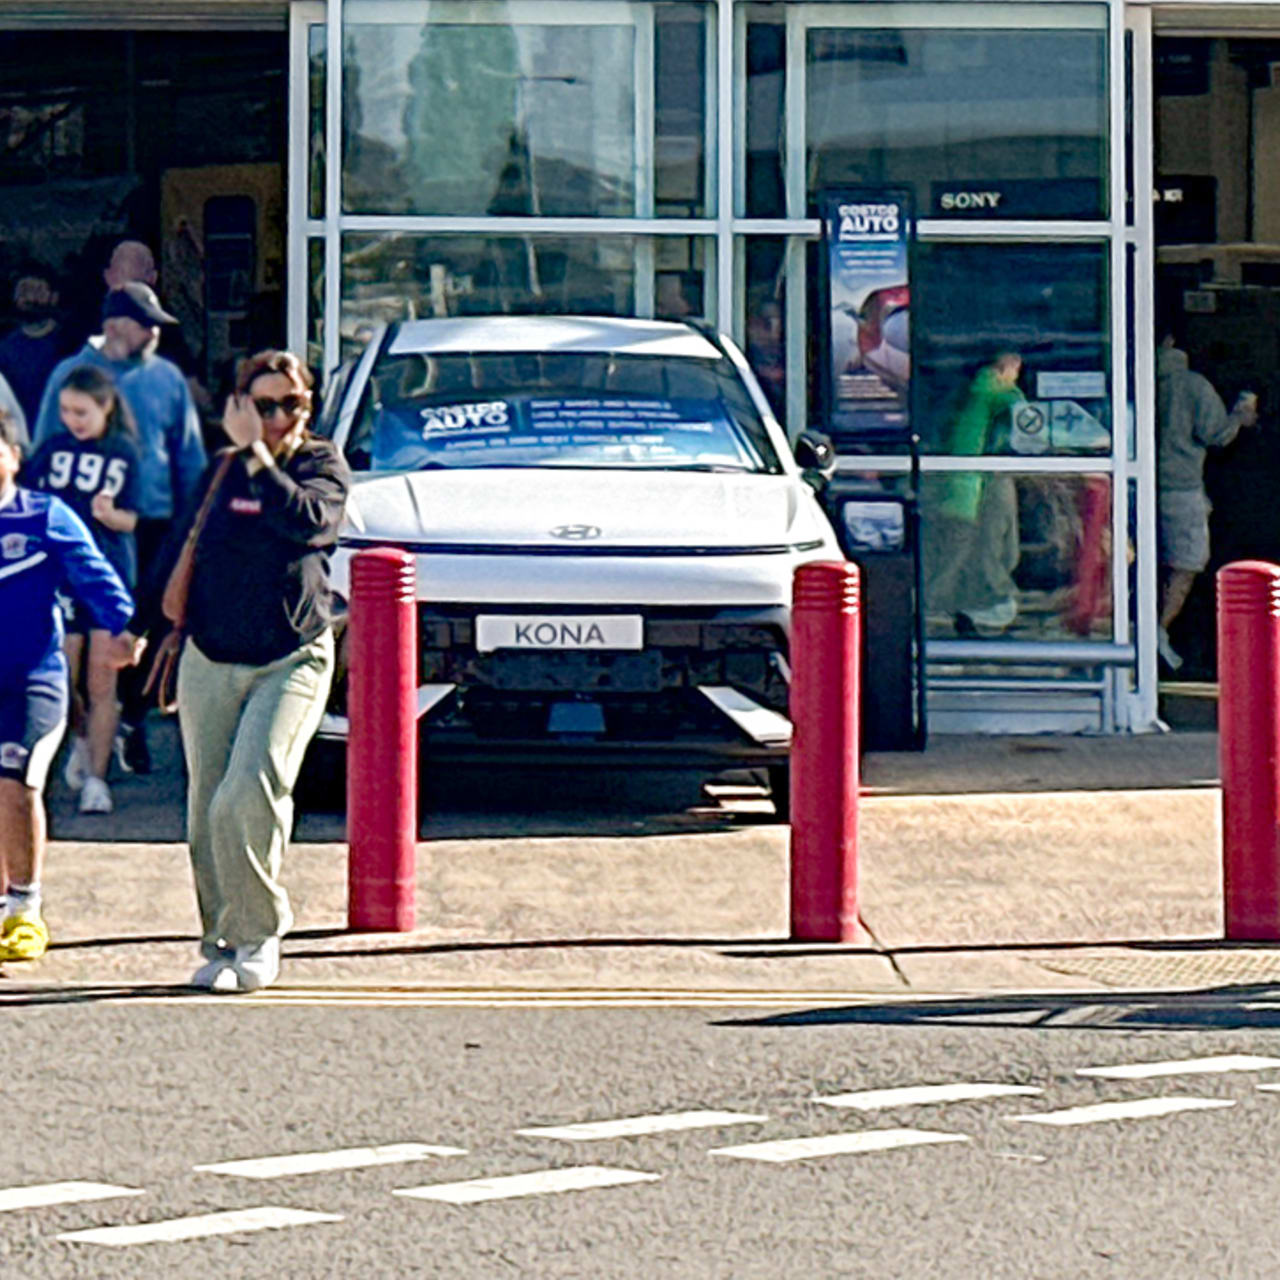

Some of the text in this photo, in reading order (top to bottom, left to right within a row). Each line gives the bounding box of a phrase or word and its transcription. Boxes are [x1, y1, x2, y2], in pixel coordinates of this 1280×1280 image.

[940, 192, 1002, 209] SONY
[838, 204, 899, 217] COSTCO
[839, 216, 899, 232] AUTO
[423, 411, 509, 431] AUTO
[515, 622, 606, 645] KONA
